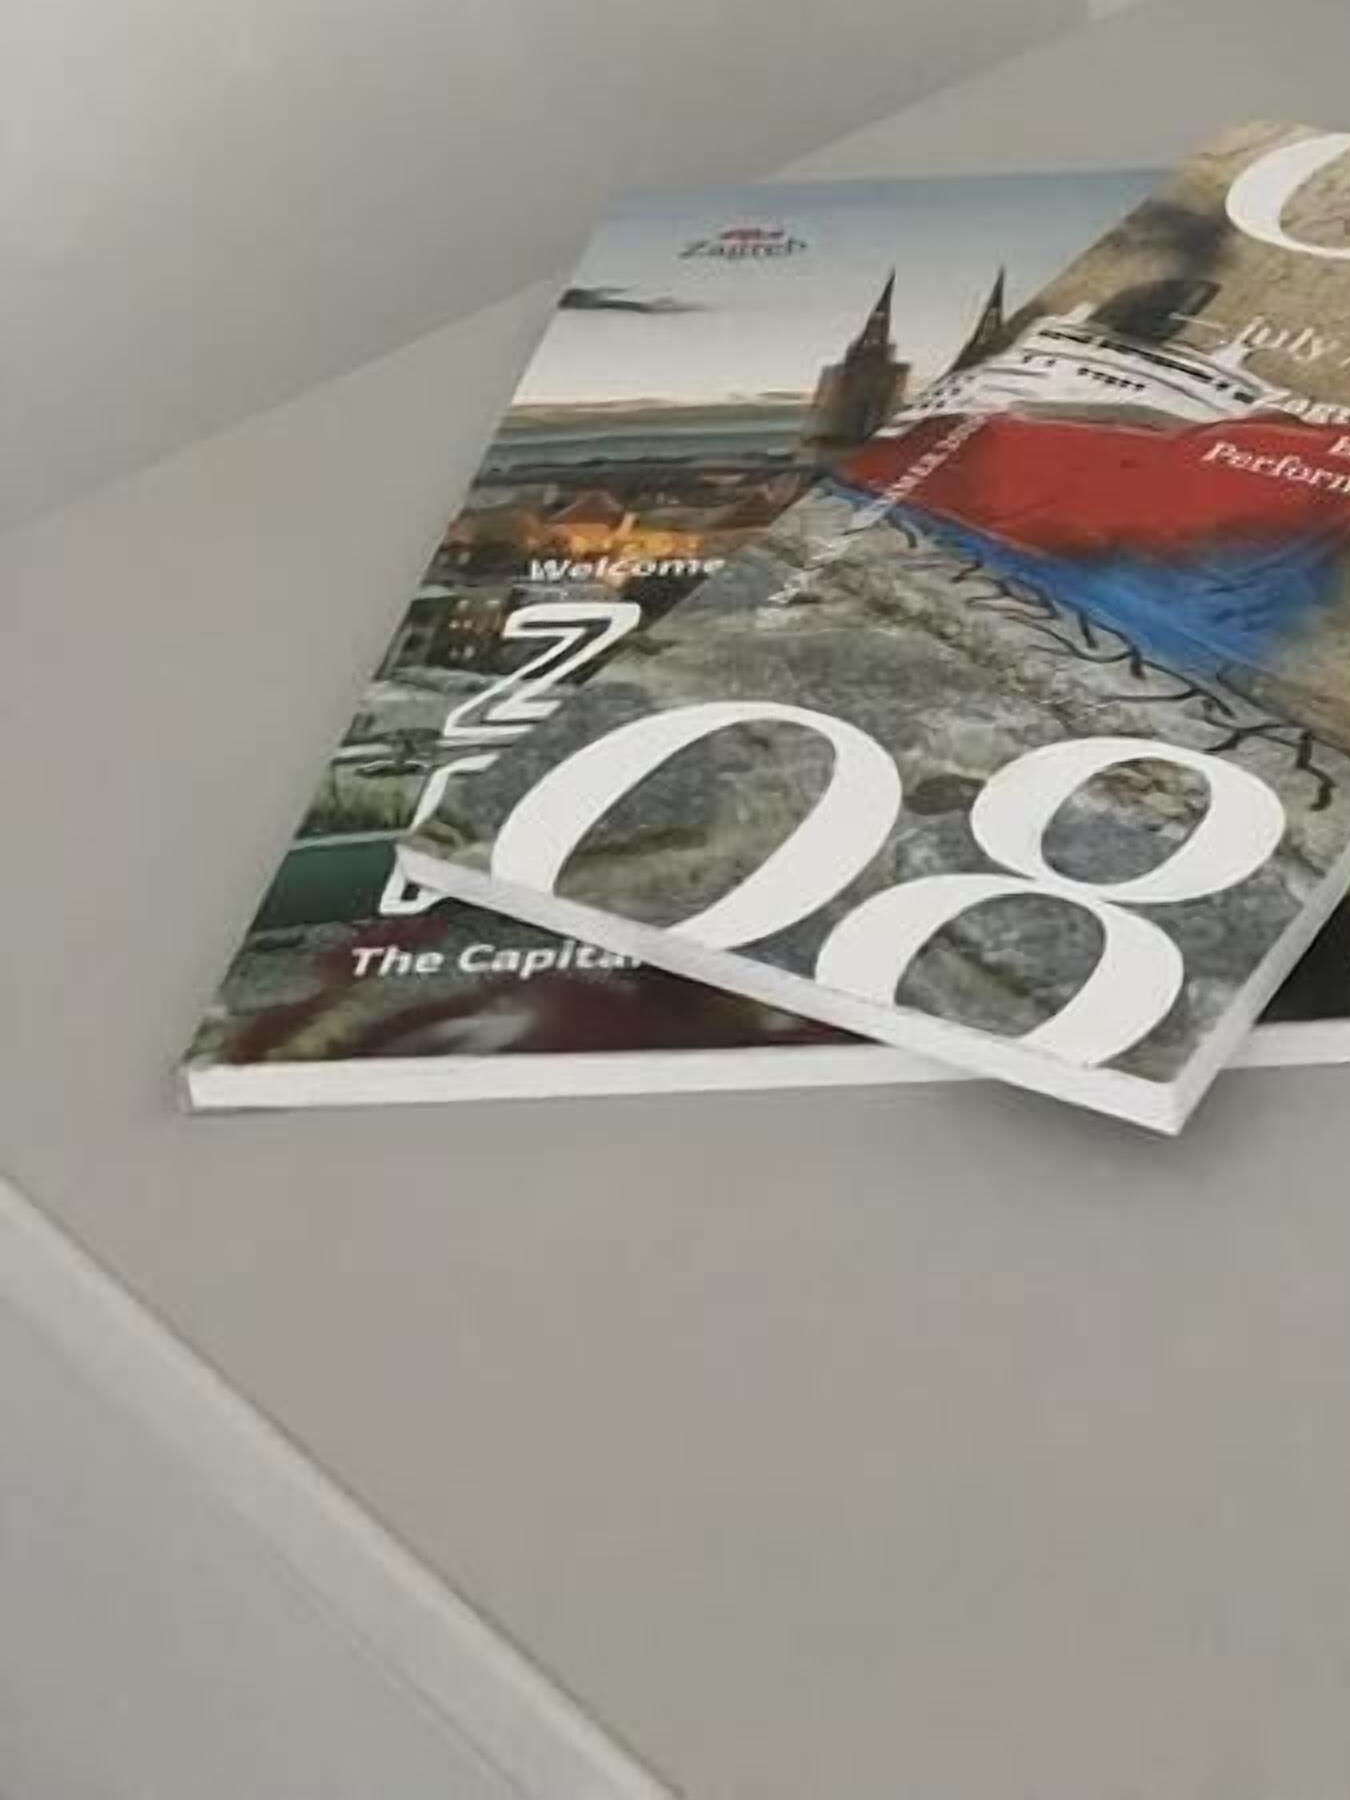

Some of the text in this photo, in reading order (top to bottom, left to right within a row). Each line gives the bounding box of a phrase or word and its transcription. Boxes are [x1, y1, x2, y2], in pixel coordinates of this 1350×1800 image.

[529, 556, 727, 583] Welcome
[490, 700, 1286, 1068] 08
[351, 938, 645, 980] The Capita
